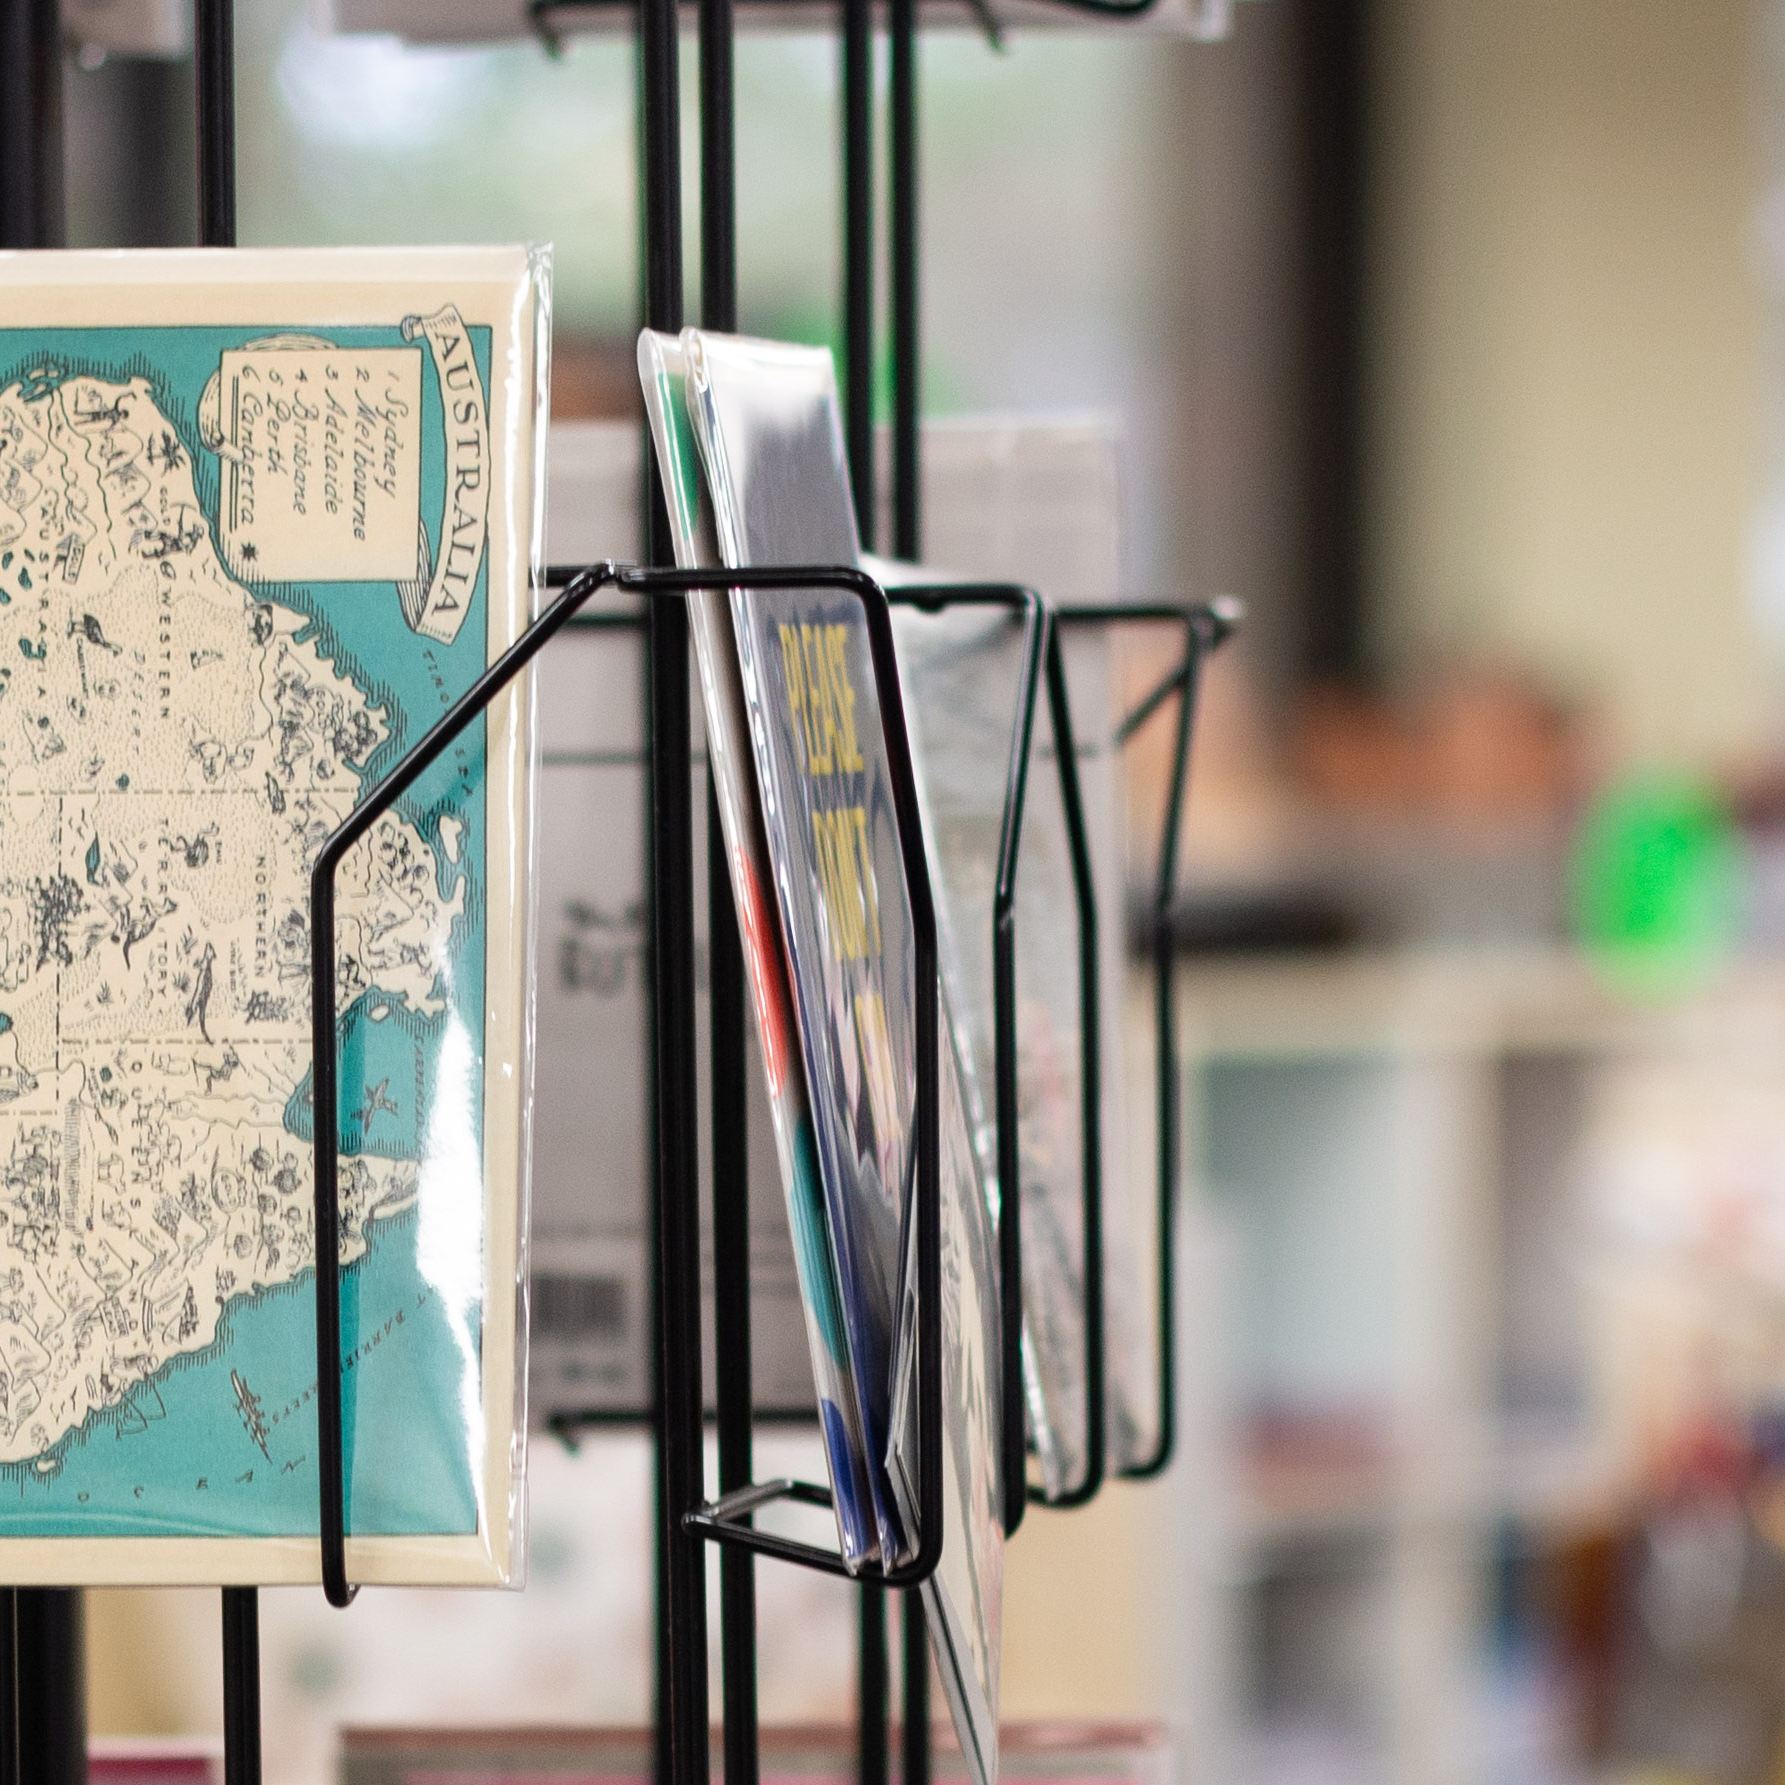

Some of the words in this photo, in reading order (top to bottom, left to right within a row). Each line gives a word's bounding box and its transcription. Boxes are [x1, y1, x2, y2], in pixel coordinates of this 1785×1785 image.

[241, 365, 261, 380] 6
[266, 391, 291, 474] Perth
[268, 370, 284, 384] 5
[295, 369, 307, 382] 4
[325, 365, 339, 380] 3
[355, 367, 370, 382] 2
[240, 392, 264, 526] Canberra
[292, 391, 319, 516] Brisbane
[324, 388, 345, 515] Adelaide
[352, 388, 376, 541] Melbourne
[375, 388, 409, 499] Sydney
[431, 332, 481, 617] AUSTRALIA
[159, 487, 171, 527] GOLD
[38, 507, 50, 699] AUSTRAIA
[159, 590, 172, 719] WESTERN
[423, 650, 450, 715] TIMO
[779, 622, 864, 777] PLEASE
[157, 818, 170, 998] TERRITORY
[255, 855, 268, 978] NORTHERN
